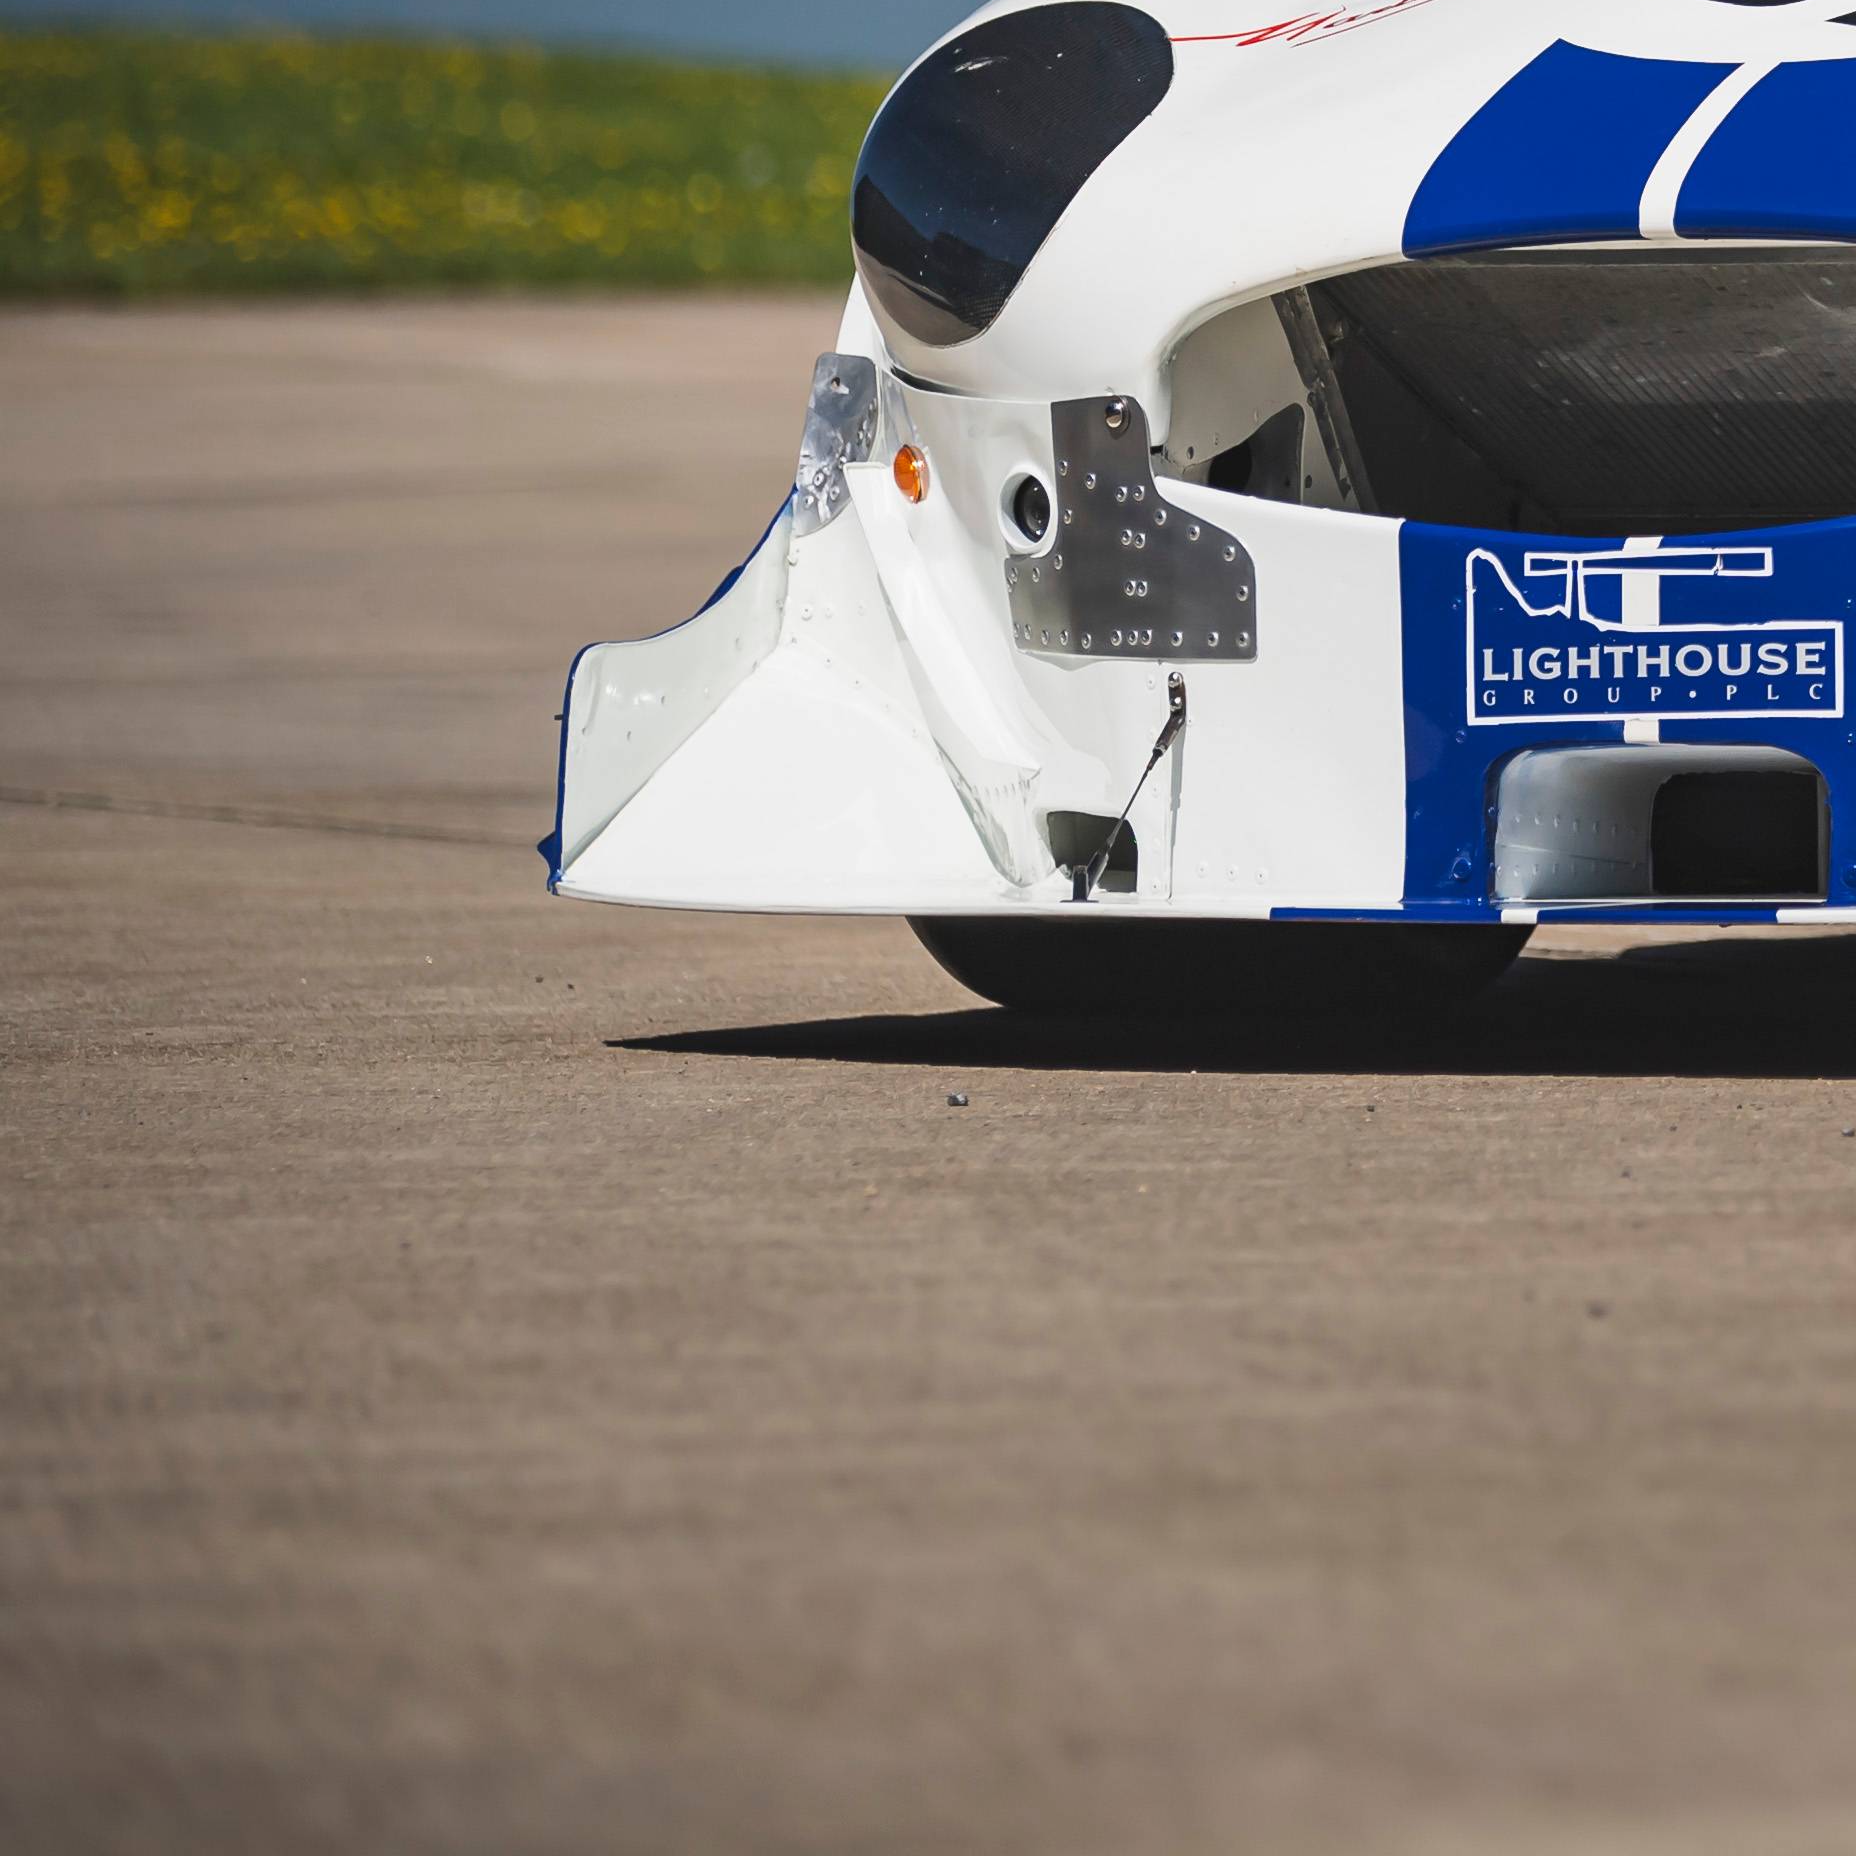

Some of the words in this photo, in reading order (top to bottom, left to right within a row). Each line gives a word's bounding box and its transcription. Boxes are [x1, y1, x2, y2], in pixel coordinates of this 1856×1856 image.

[1482, 641, 1827, 683] LIGHTHOUSE
[1482, 685, 1663, 707] GROUP
[1726, 683, 1824, 701] PLC
